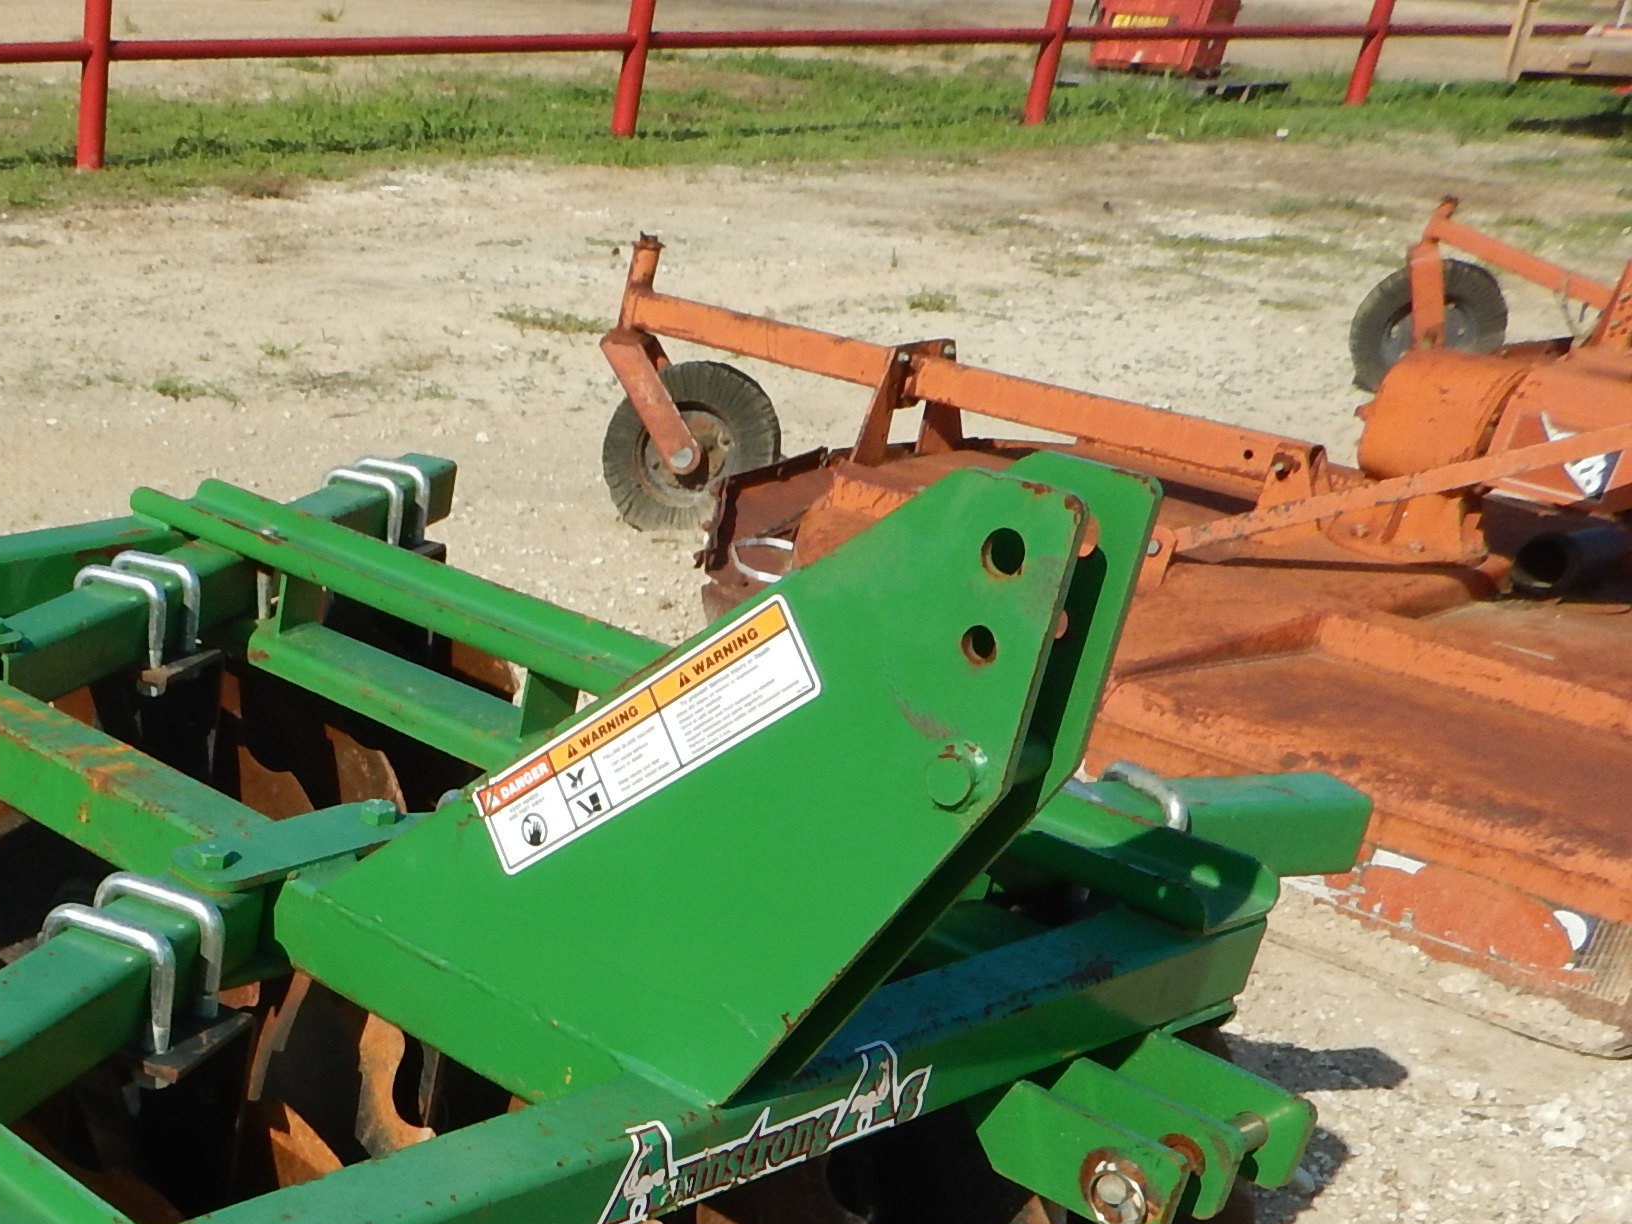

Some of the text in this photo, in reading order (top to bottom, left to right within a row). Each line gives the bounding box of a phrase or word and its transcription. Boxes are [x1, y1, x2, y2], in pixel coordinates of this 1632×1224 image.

[691, 627, 759, 678] WARNING
[578, 704, 639, 750] WARNING
[499, 762, 549, 800] DANGER
